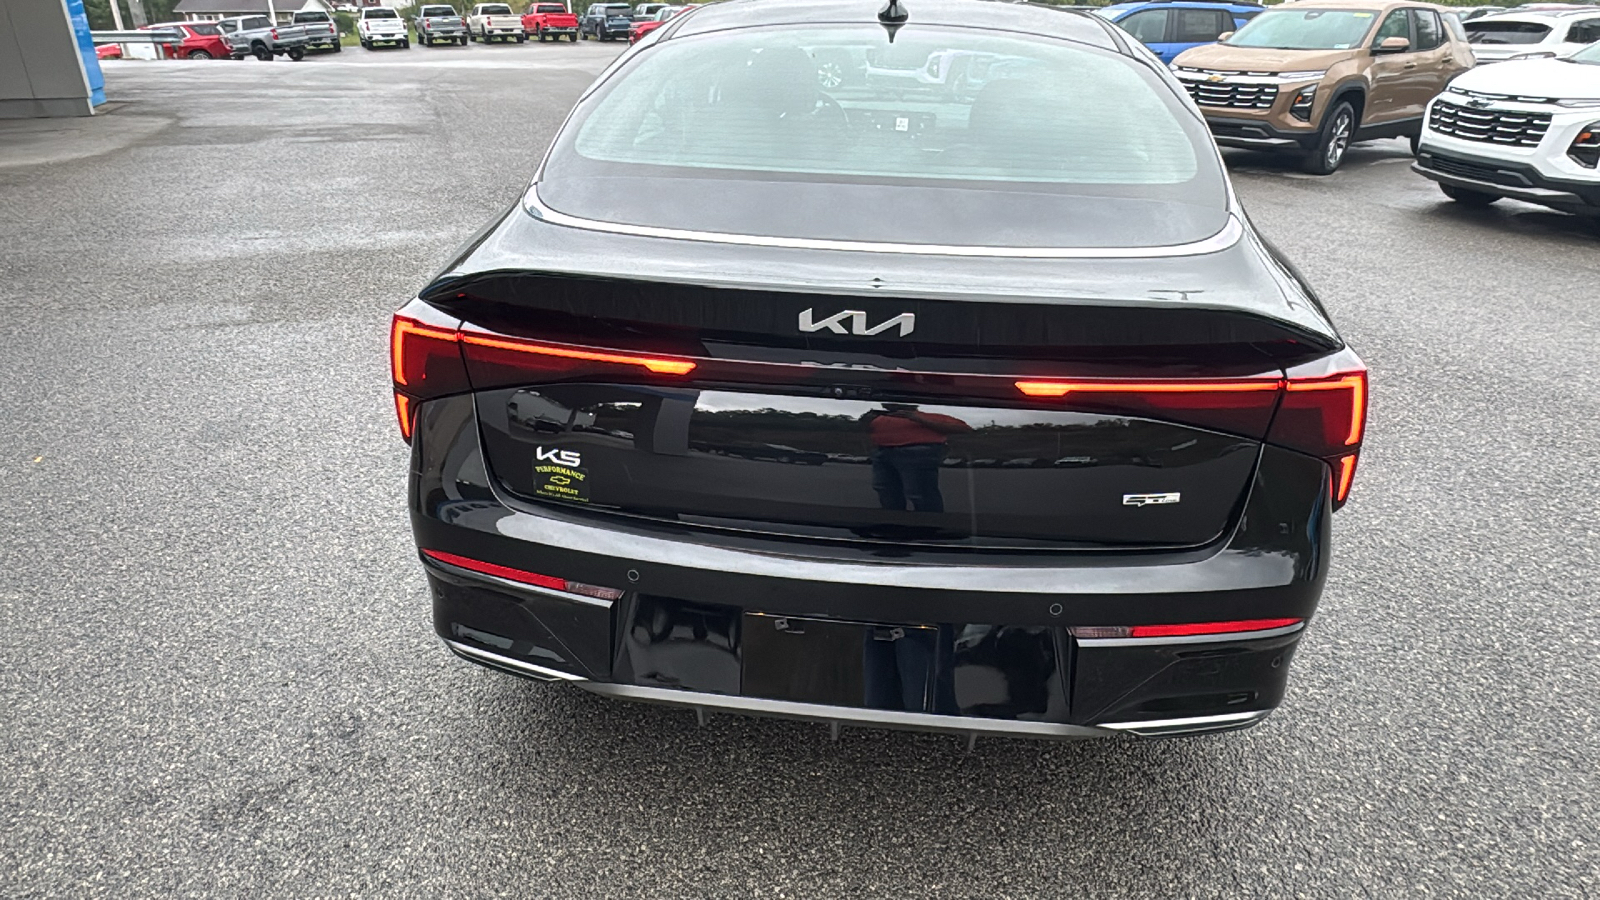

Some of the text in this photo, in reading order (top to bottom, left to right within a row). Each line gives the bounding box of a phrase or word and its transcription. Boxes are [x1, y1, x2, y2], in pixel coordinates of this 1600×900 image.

[799, 308, 915, 337] KIA
[536, 446, 581, 467] K5
[535, 465, 586, 481] PERFORMANCE
[544, 484, 579, 495] CHEVROLET
